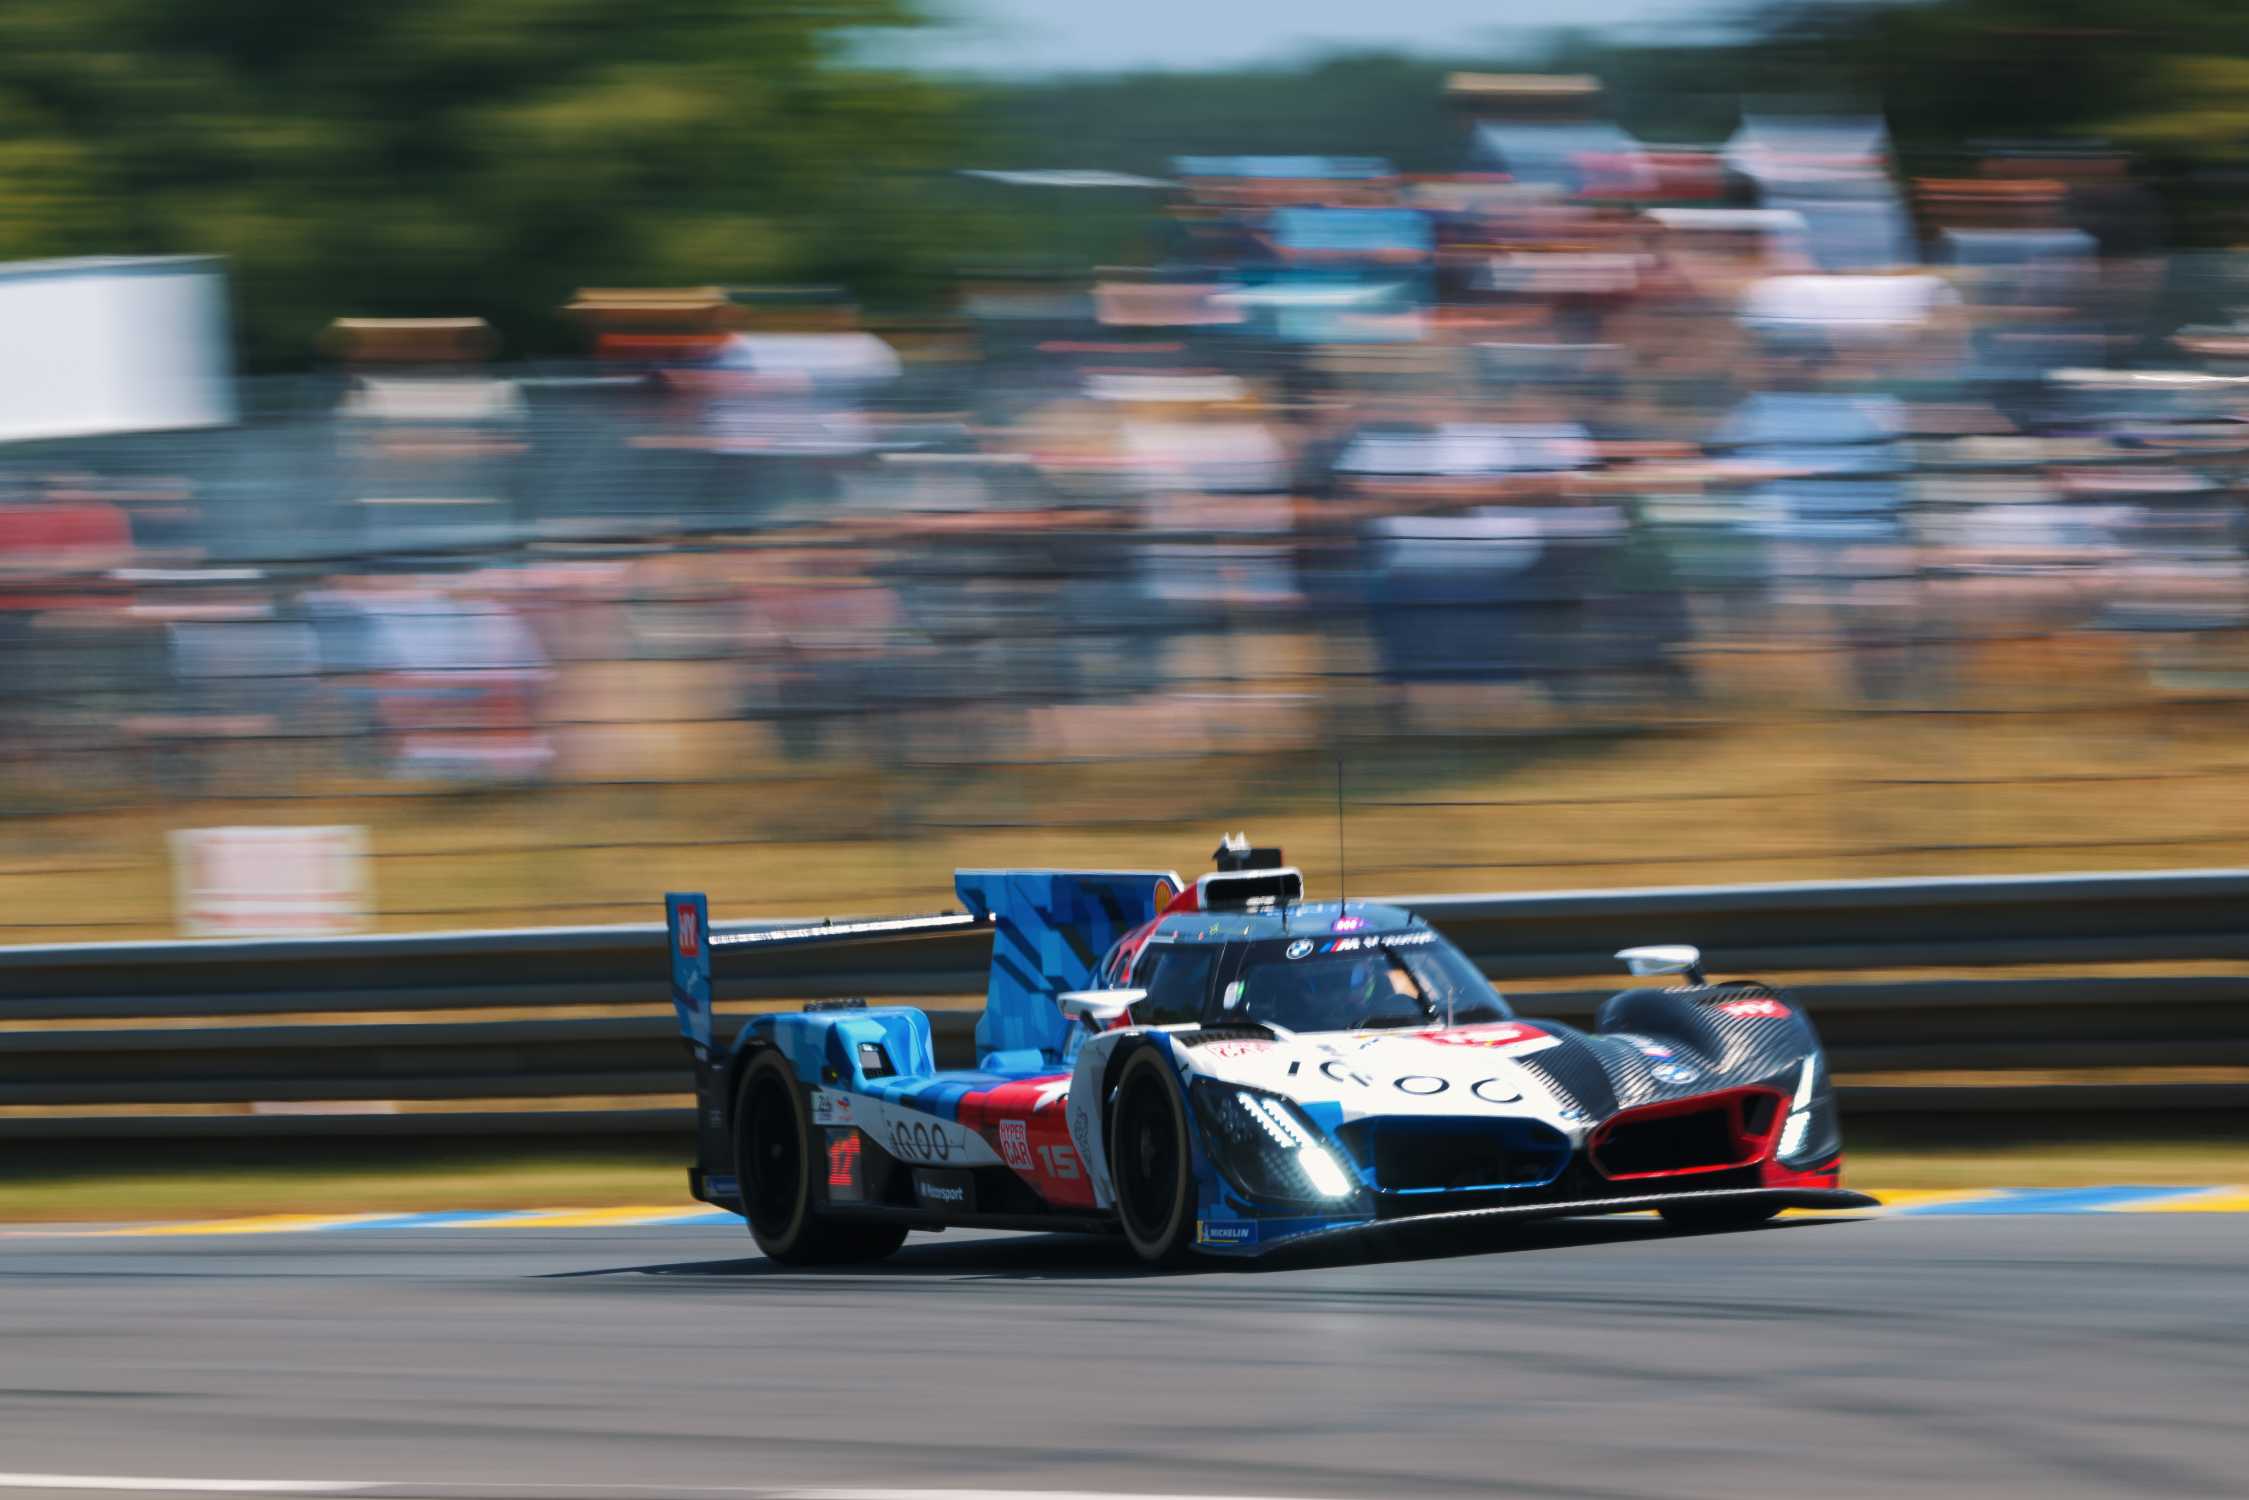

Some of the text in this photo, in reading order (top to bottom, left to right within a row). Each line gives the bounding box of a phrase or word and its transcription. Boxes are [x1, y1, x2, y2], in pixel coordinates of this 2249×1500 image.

[1000, 1122, 1026, 1141] HYPER
[1005, 1140, 1030, 1165] CAR
[1037, 1145, 1080, 1179] 15
